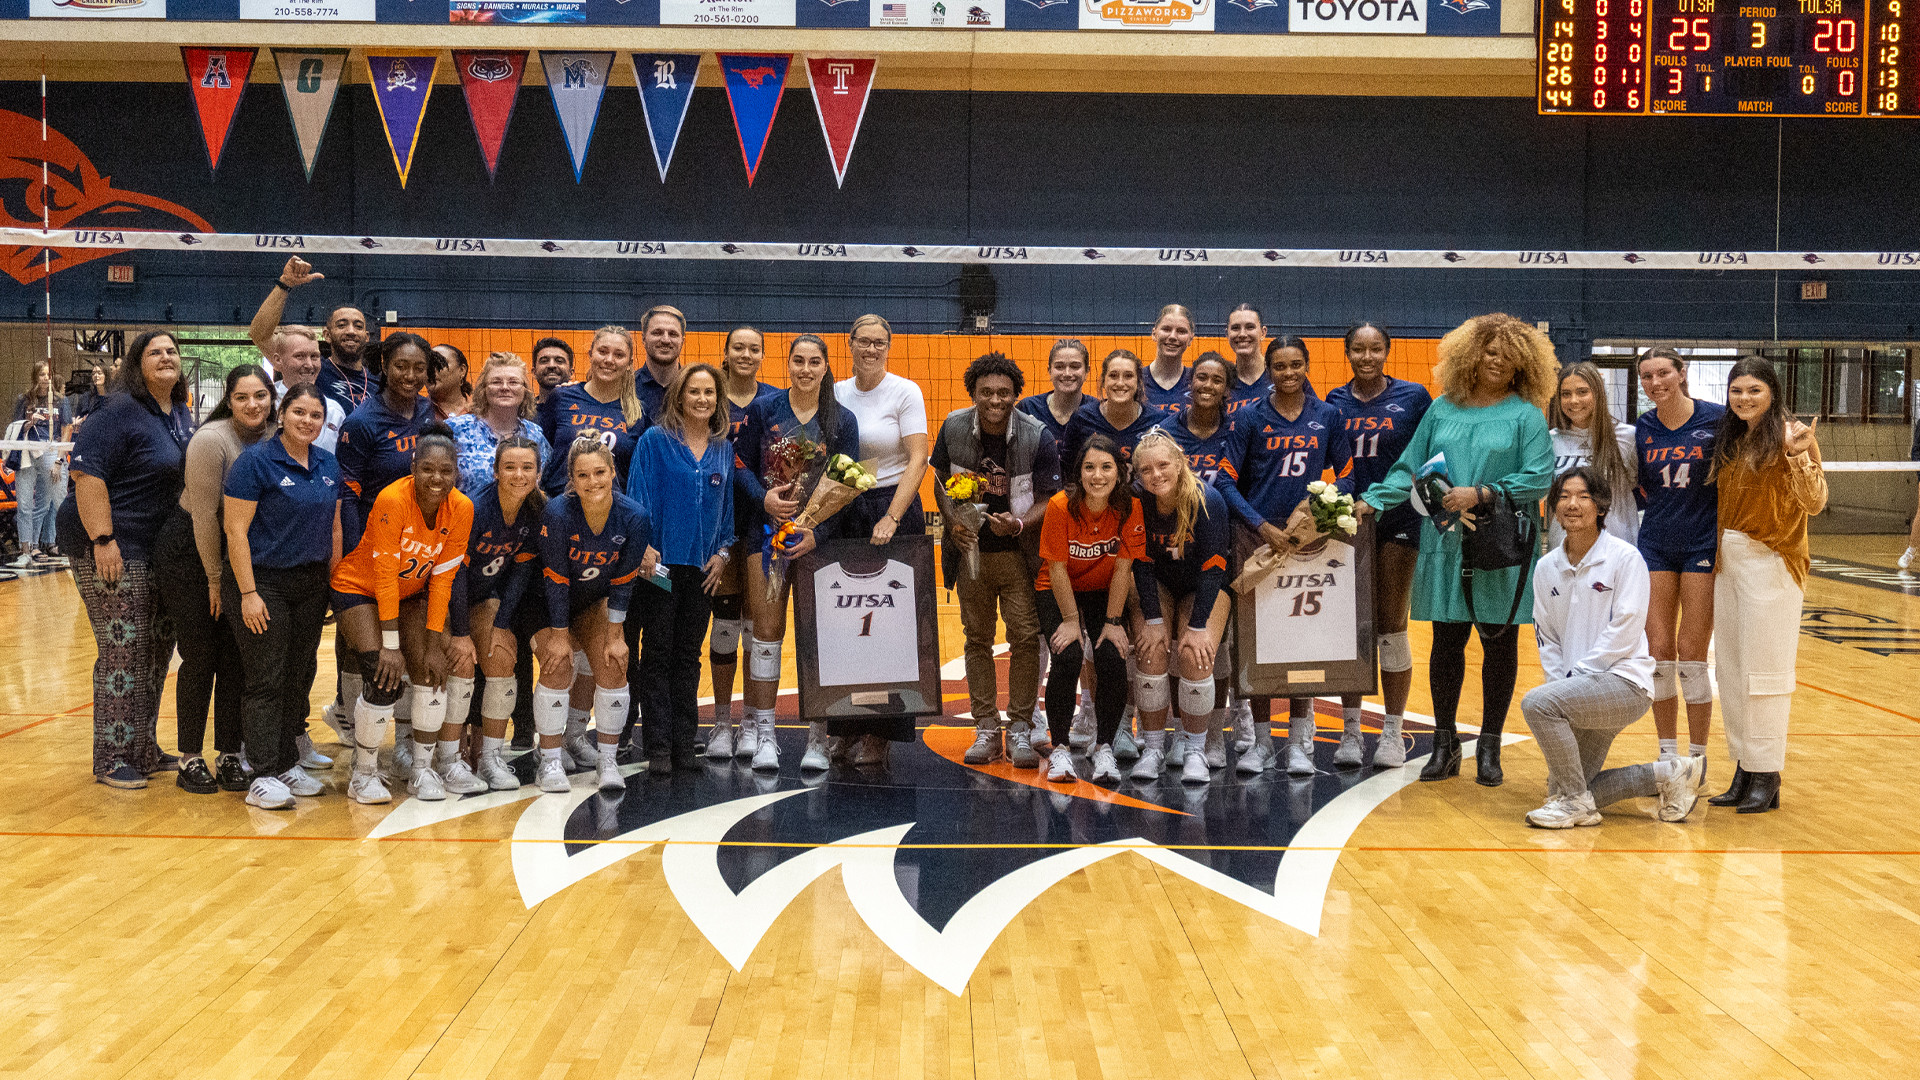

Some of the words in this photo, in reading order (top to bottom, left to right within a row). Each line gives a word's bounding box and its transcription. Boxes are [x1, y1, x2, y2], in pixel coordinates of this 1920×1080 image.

[274, 8, 338, 16] 210-558-7774
[556, 3, 580, 11] WRAPS
[1107, 8, 1187, 16] PIZZAWORKS
[1297, 0, 1419, 21] TOYOTA
[1562, 0, 1574, 15] 9
[1596, 0, 1608, 16] 0
[1630, 0, 1642, 17] 0
[1739, 7, 1776, 18] PERIOD
[1889, 0, 1900, 18] 9
[694, 14, 759, 23] 210-561-0200
[1555, 21, 1574, 38] 14
[1597, 20, 1607, 39] 3
[1630, 22, 1641, 38] 4
[1669, 17, 1710, 51] 25
[1751, 21, 1765, 48] 3
[1814, 19, 1856, 52] 20
[1881, 23, 1900, 42] 10
[1547, 42, 1573, 62] 20
[1595, 43, 1607, 62] 0
[1629, 43, 1641, 63] 0
[1654, 55, 1687, 66] FOULS
[1880, 46, 1899, 65] 12
[1695, 64, 1715, 72] T.O.L.
[1724, 56, 1763, 67] PLAYER
[1766, 56, 1792, 67] FOUL
[1799, 65, 1819, 73] T.O.L.
[1826, 57, 1859, 68] FOULS
[201, 55, 231, 88] A
[653, 60, 677, 90] R
[828, 63, 854, 94] T
[1546, 65, 1572, 86] 26
[1594, 66, 1606, 86] 0
[1621, 68, 1640, 84] 11
[1879, 69, 1898, 88] 13
[1668, 68, 1682, 94] 3
[1705, 75, 1711, 92] 1
[1802, 75, 1815, 95] 0
[1838, 70, 1854, 96] 0
[1545, 90, 1572, 107] 44
[1594, 89, 1606, 109] 0
[1627, 89, 1639, 109] 6
[1653, 100, 1687, 111] SCORE
[1738, 101, 1773, 112] MATCH
[1825, 102, 1858, 112] SCORE
[1879, 92, 1897, 111] 18
[75, 231, 125, 244] UTSA
[255, 235, 305, 248] UTSA
[436, 239, 486, 251] UTSA
[616, 242, 667, 254] UTSA
[797, 244, 847, 256] UTSA
[978, 247, 1028, 259] UTSA
[1159, 249, 1208, 261] UTSA
[1339, 251, 1388, 263] UTSA
[1519, 252, 1568, 264] UTSA
[1698, 253, 1748, 265] UTSA
[113, 266, 130, 281] EXIT
[1805, 283, 1822, 297] EXIT
[571, 414, 627, 433] UTSA
[396, 434, 418, 452] UT
[1266, 435, 1319, 450] UTSA
[1354, 433, 1380, 458] 11
[1186, 454, 1220, 467] TS
[1554, 454, 1593, 469] UTS
[1646, 446, 1703, 463] UTSA
[1279, 452, 1308, 477] 15
[1659, 463, 1690, 488] 14
[540, 524, 549, 537] A
[401, 537, 443, 558] UTSA
[1069, 545, 1100, 557] BIRDS
[569, 547, 619, 566] UTSA
[399, 558, 434, 579] 20
[482, 556, 504, 576] 8
[578, 567, 600, 581] 9
[1275, 573, 1337, 589] UTSA
[835, 594, 895, 608] UTSA
[1289, 590, 1324, 617] 15
[858, 611, 873, 637] 1
